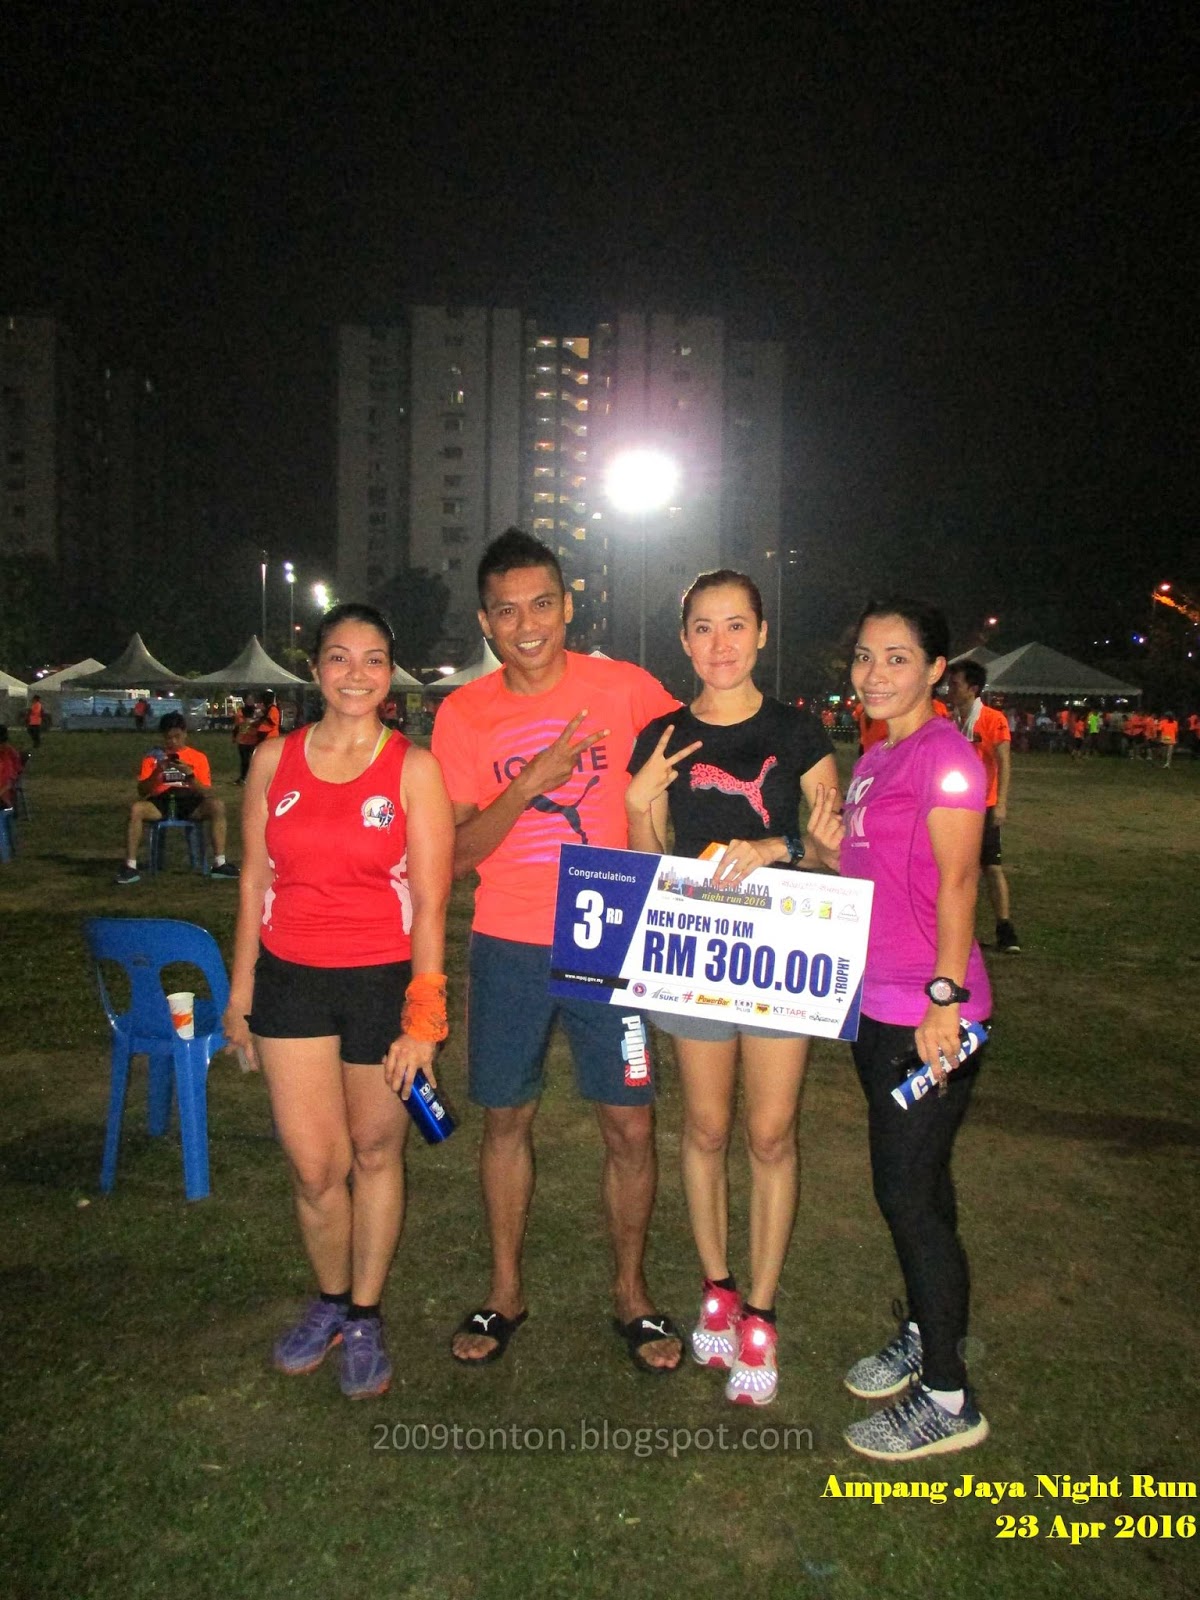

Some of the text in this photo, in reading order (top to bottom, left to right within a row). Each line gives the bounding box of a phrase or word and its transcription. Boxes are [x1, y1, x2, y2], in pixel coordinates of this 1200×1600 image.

[493, 745, 609, 784] IGTE
[568, 866, 637, 884] Congratulations
[744, 883, 770, 897] JAYA
[701, 892, 767, 907] night run 2016
[646, 909, 754, 939] MEN OPEN 10 KM
[642, 930, 833, 998] RM 300.00
[836, 956, 851, 996] TROPHY
[658, 993, 680, 1003] SUKE
[697, 994, 730, 1006] PowerBar
[773, 1006, 785, 1014] KT
[785, 1007, 807, 1018] TAPE
[621, 1015, 648, 1079] PUMA
